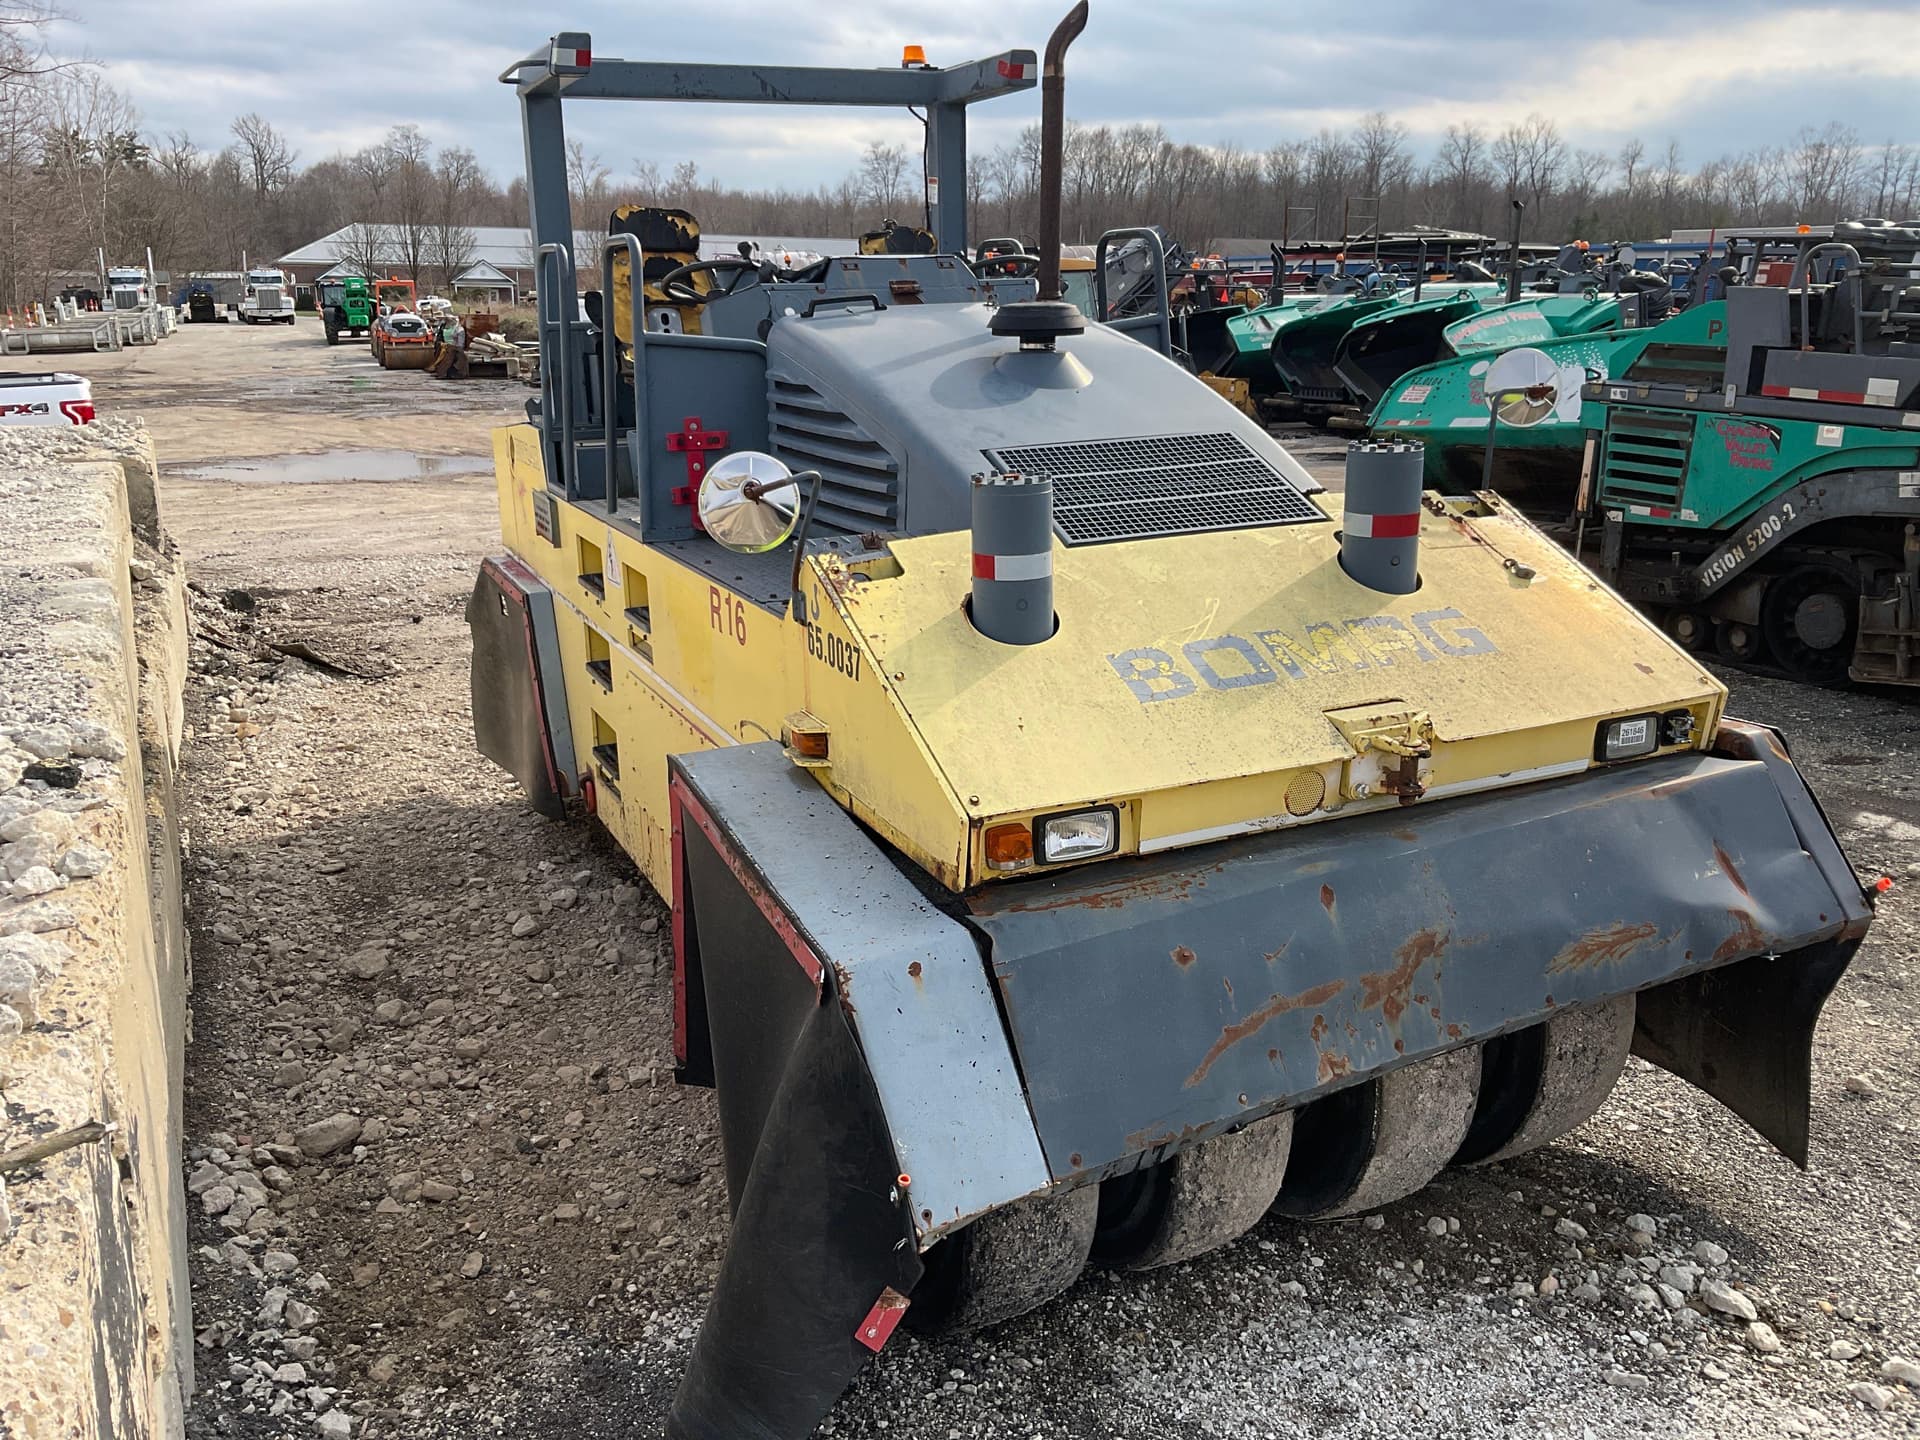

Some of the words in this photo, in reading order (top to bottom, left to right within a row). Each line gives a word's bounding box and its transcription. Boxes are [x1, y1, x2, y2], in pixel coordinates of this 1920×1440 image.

[1708, 319, 1723, 339] P
[1702, 545, 1746, 587] VISION
[709, 585, 747, 647] R16
[807, 621, 861, 682] 65.0037
[1106, 606, 1500, 704] BOMAG
